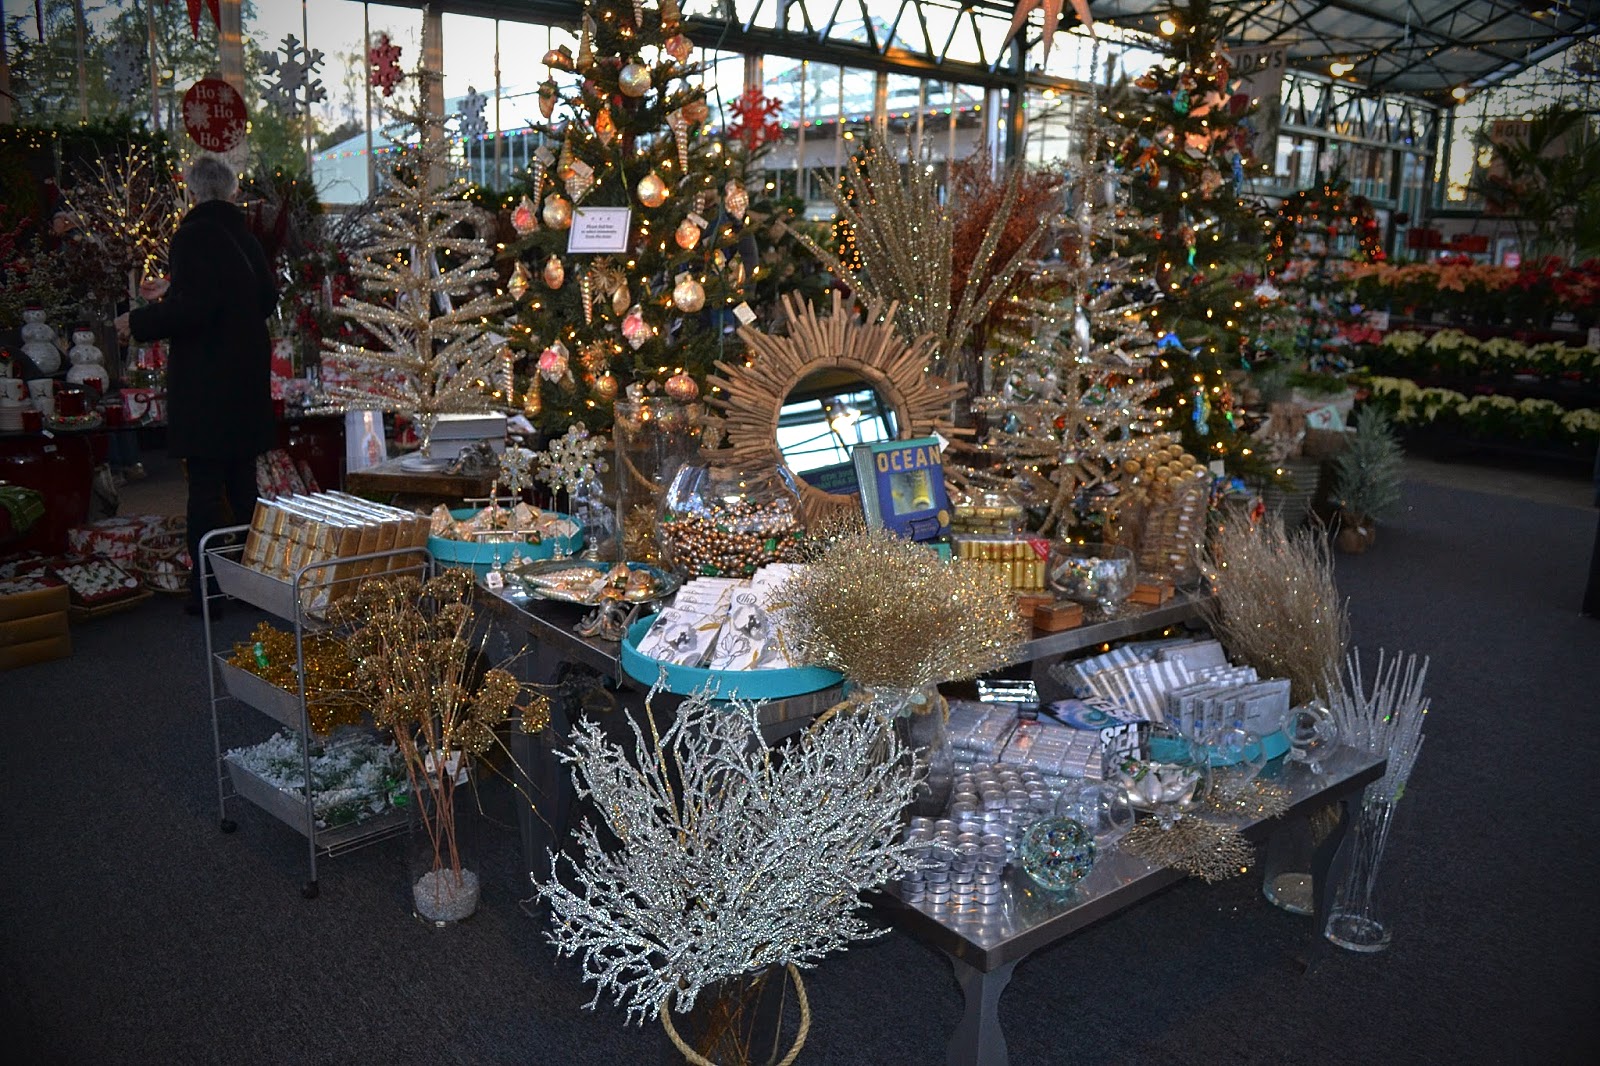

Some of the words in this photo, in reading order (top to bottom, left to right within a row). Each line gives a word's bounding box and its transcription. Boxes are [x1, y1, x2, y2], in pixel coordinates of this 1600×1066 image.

[195, 85, 216, 100] Ho
[213, 104, 234, 119] Ho
[200, 132, 220, 147] Ho
[876, 446, 941, 473] OCEAN
[1100, 722, 1140, 753] SEA
